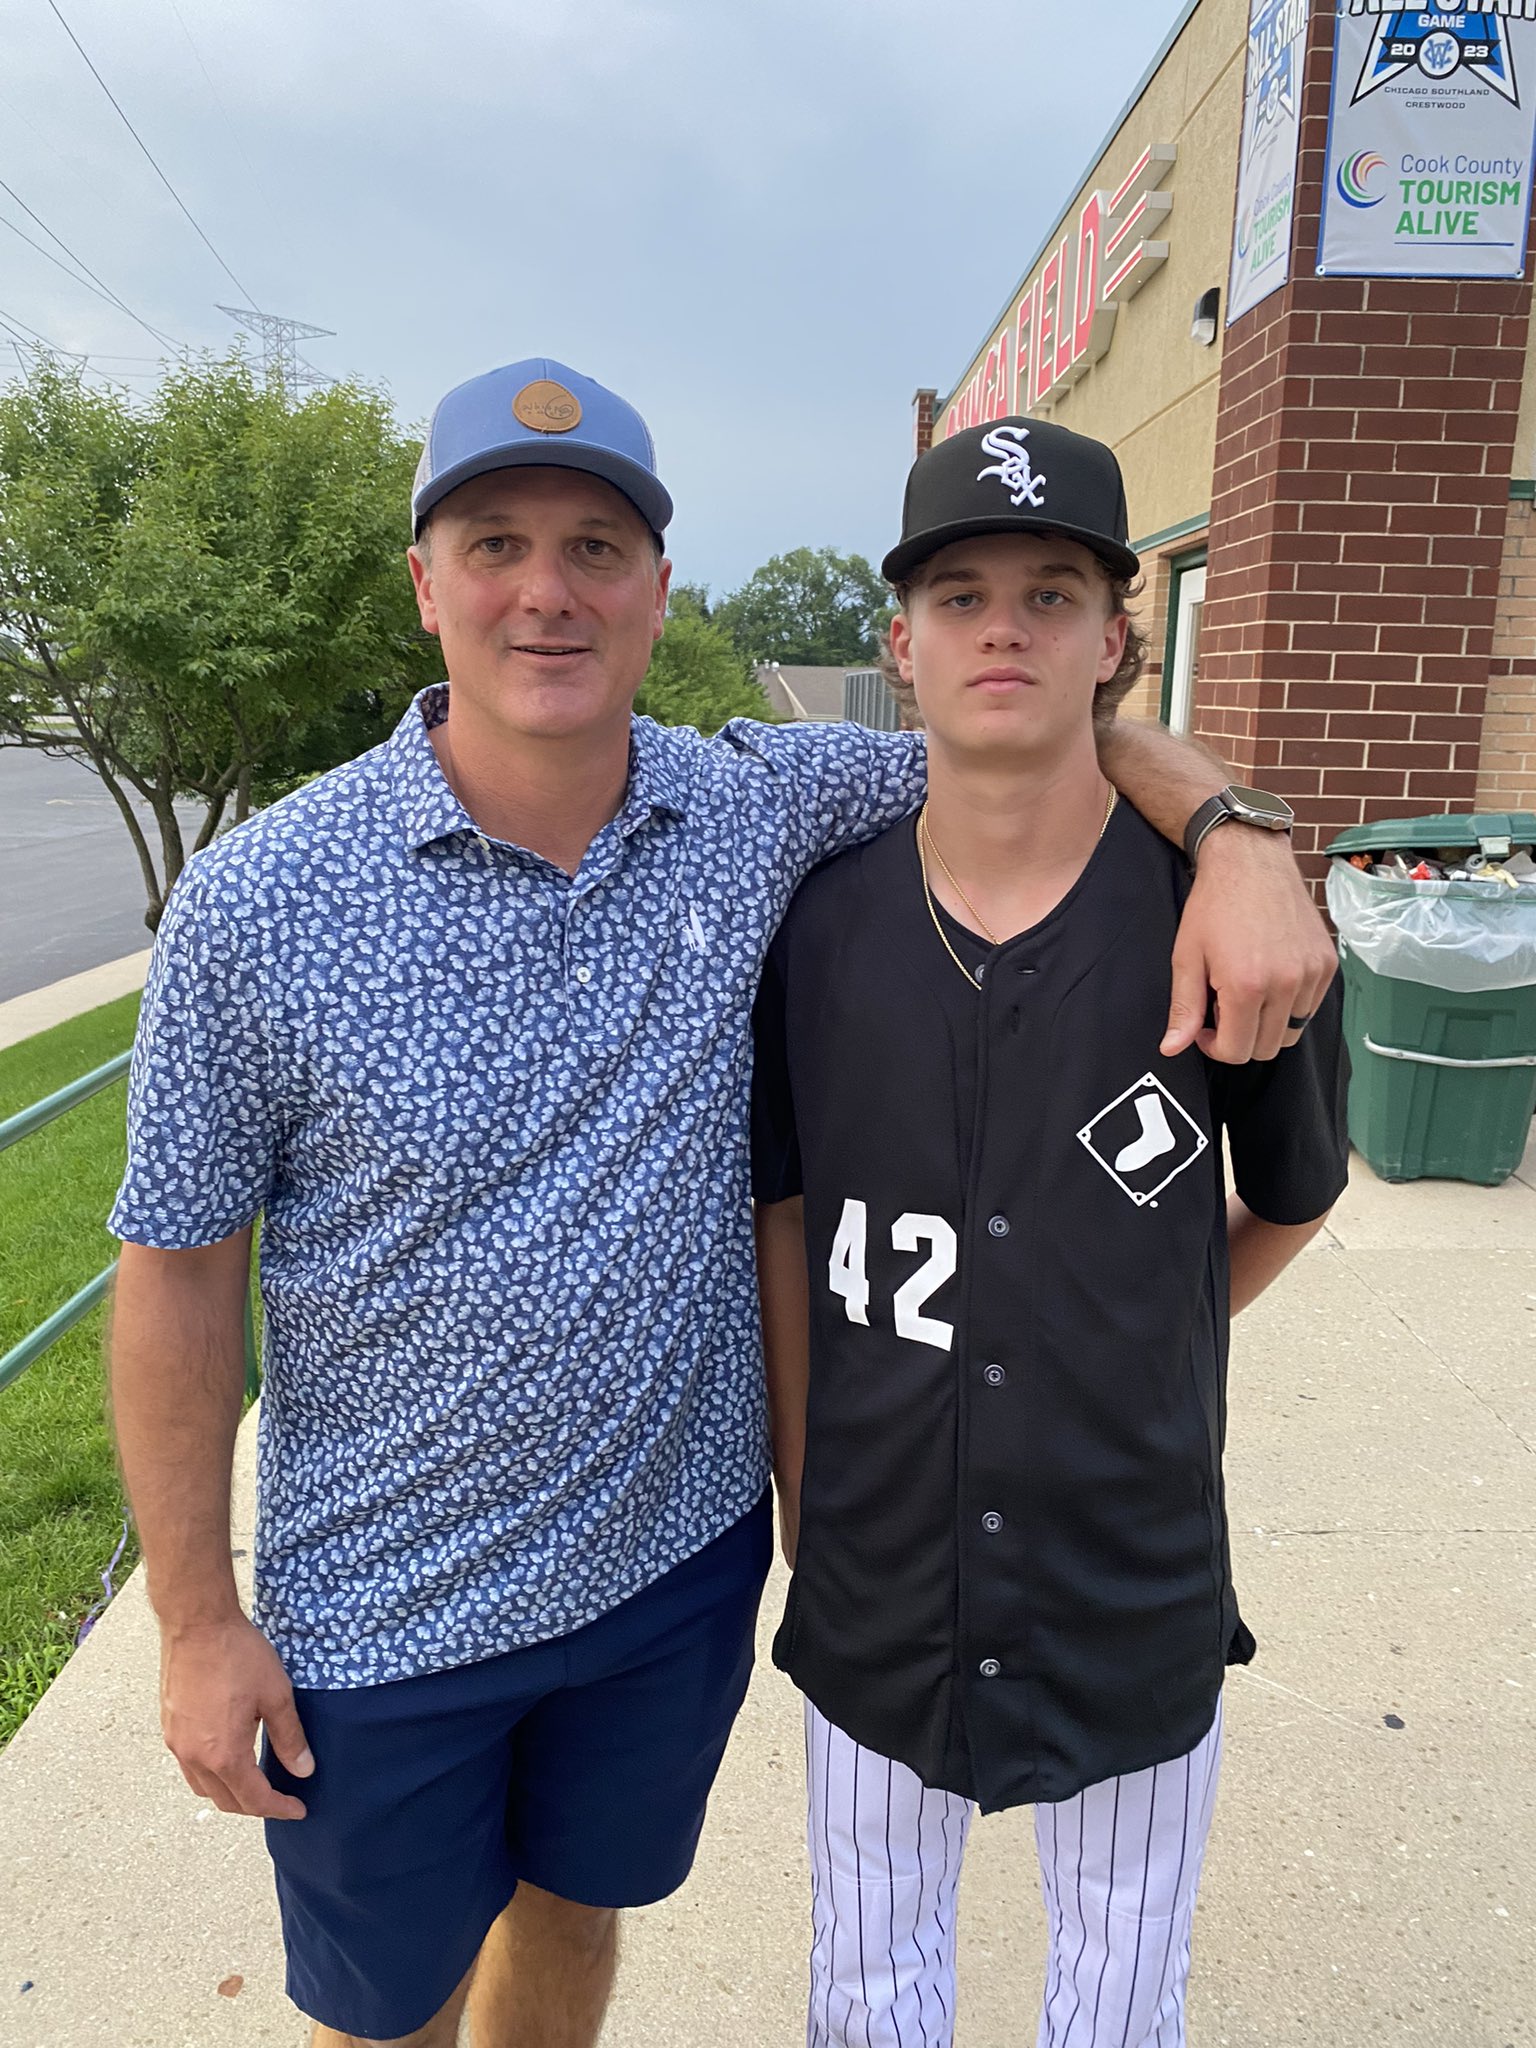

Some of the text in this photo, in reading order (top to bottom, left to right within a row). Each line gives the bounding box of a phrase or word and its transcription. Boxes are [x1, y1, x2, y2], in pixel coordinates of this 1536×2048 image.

[1417, 14, 1466, 29] GAME
[1390, 43, 1416, 56] 20
[1463, 45, 1489, 58] 23
[1384, 86, 1490, 96] CHICAGO SOUTHLAND
[1405, 101, 1466, 109] CRESTWOOD
[1401, 153, 1524, 179] Cook County
[1399, 179, 1521, 206] TOURISM
[1395, 210, 1479, 235] ALIVE
[1013, 190, 1101, 417] FIELD
[828, 1197, 958, 1352] 42
